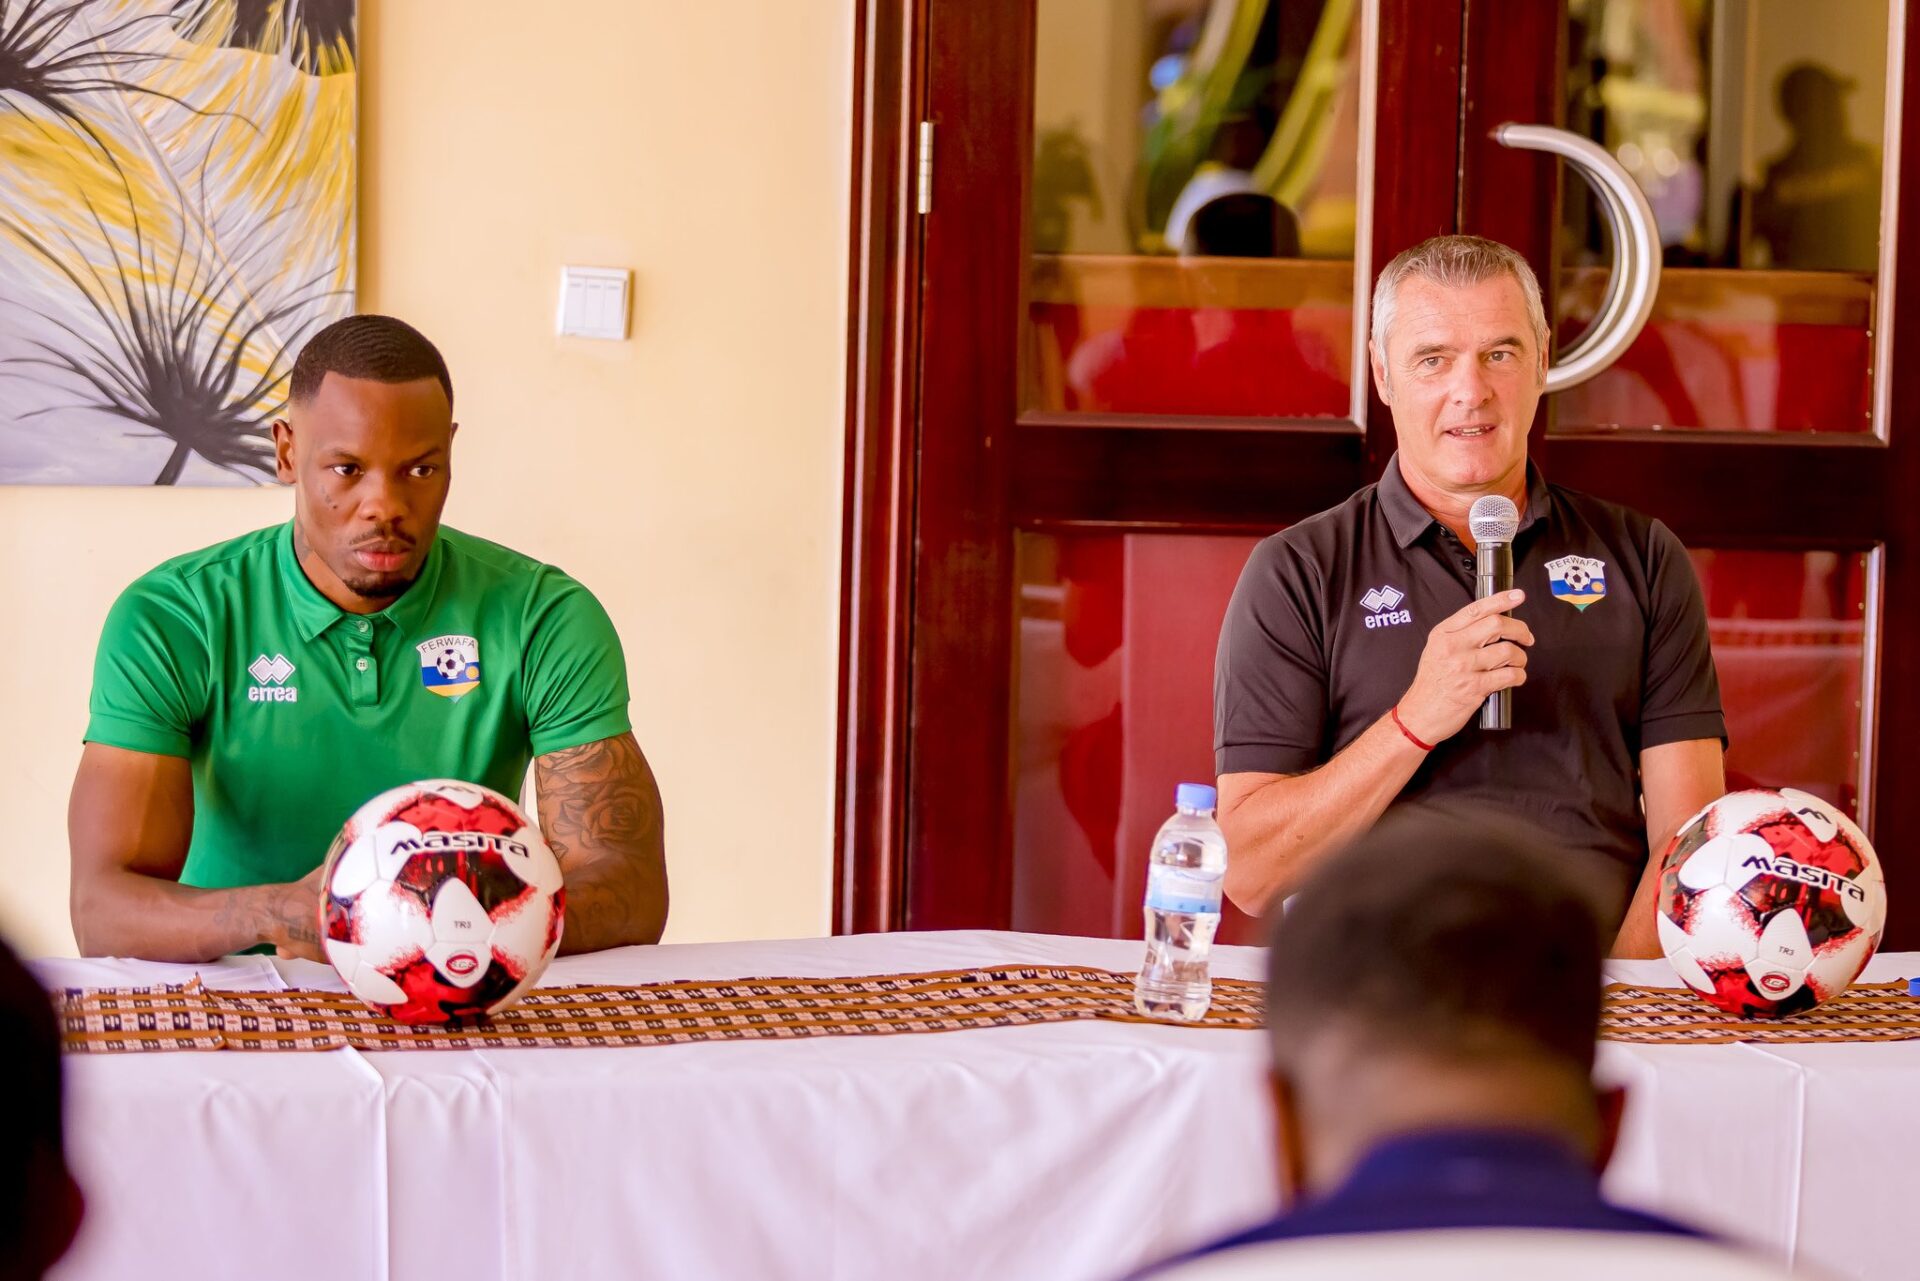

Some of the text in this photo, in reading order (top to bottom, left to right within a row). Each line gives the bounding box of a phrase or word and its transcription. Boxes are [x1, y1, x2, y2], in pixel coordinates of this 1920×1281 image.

[1549, 556, 1600, 570] FERWAFA
[1364, 609, 1412, 629] errea
[420, 637, 476, 654] FERWAFA
[248, 686, 298, 702] errea
[1778, 946, 1795, 956] TR3
